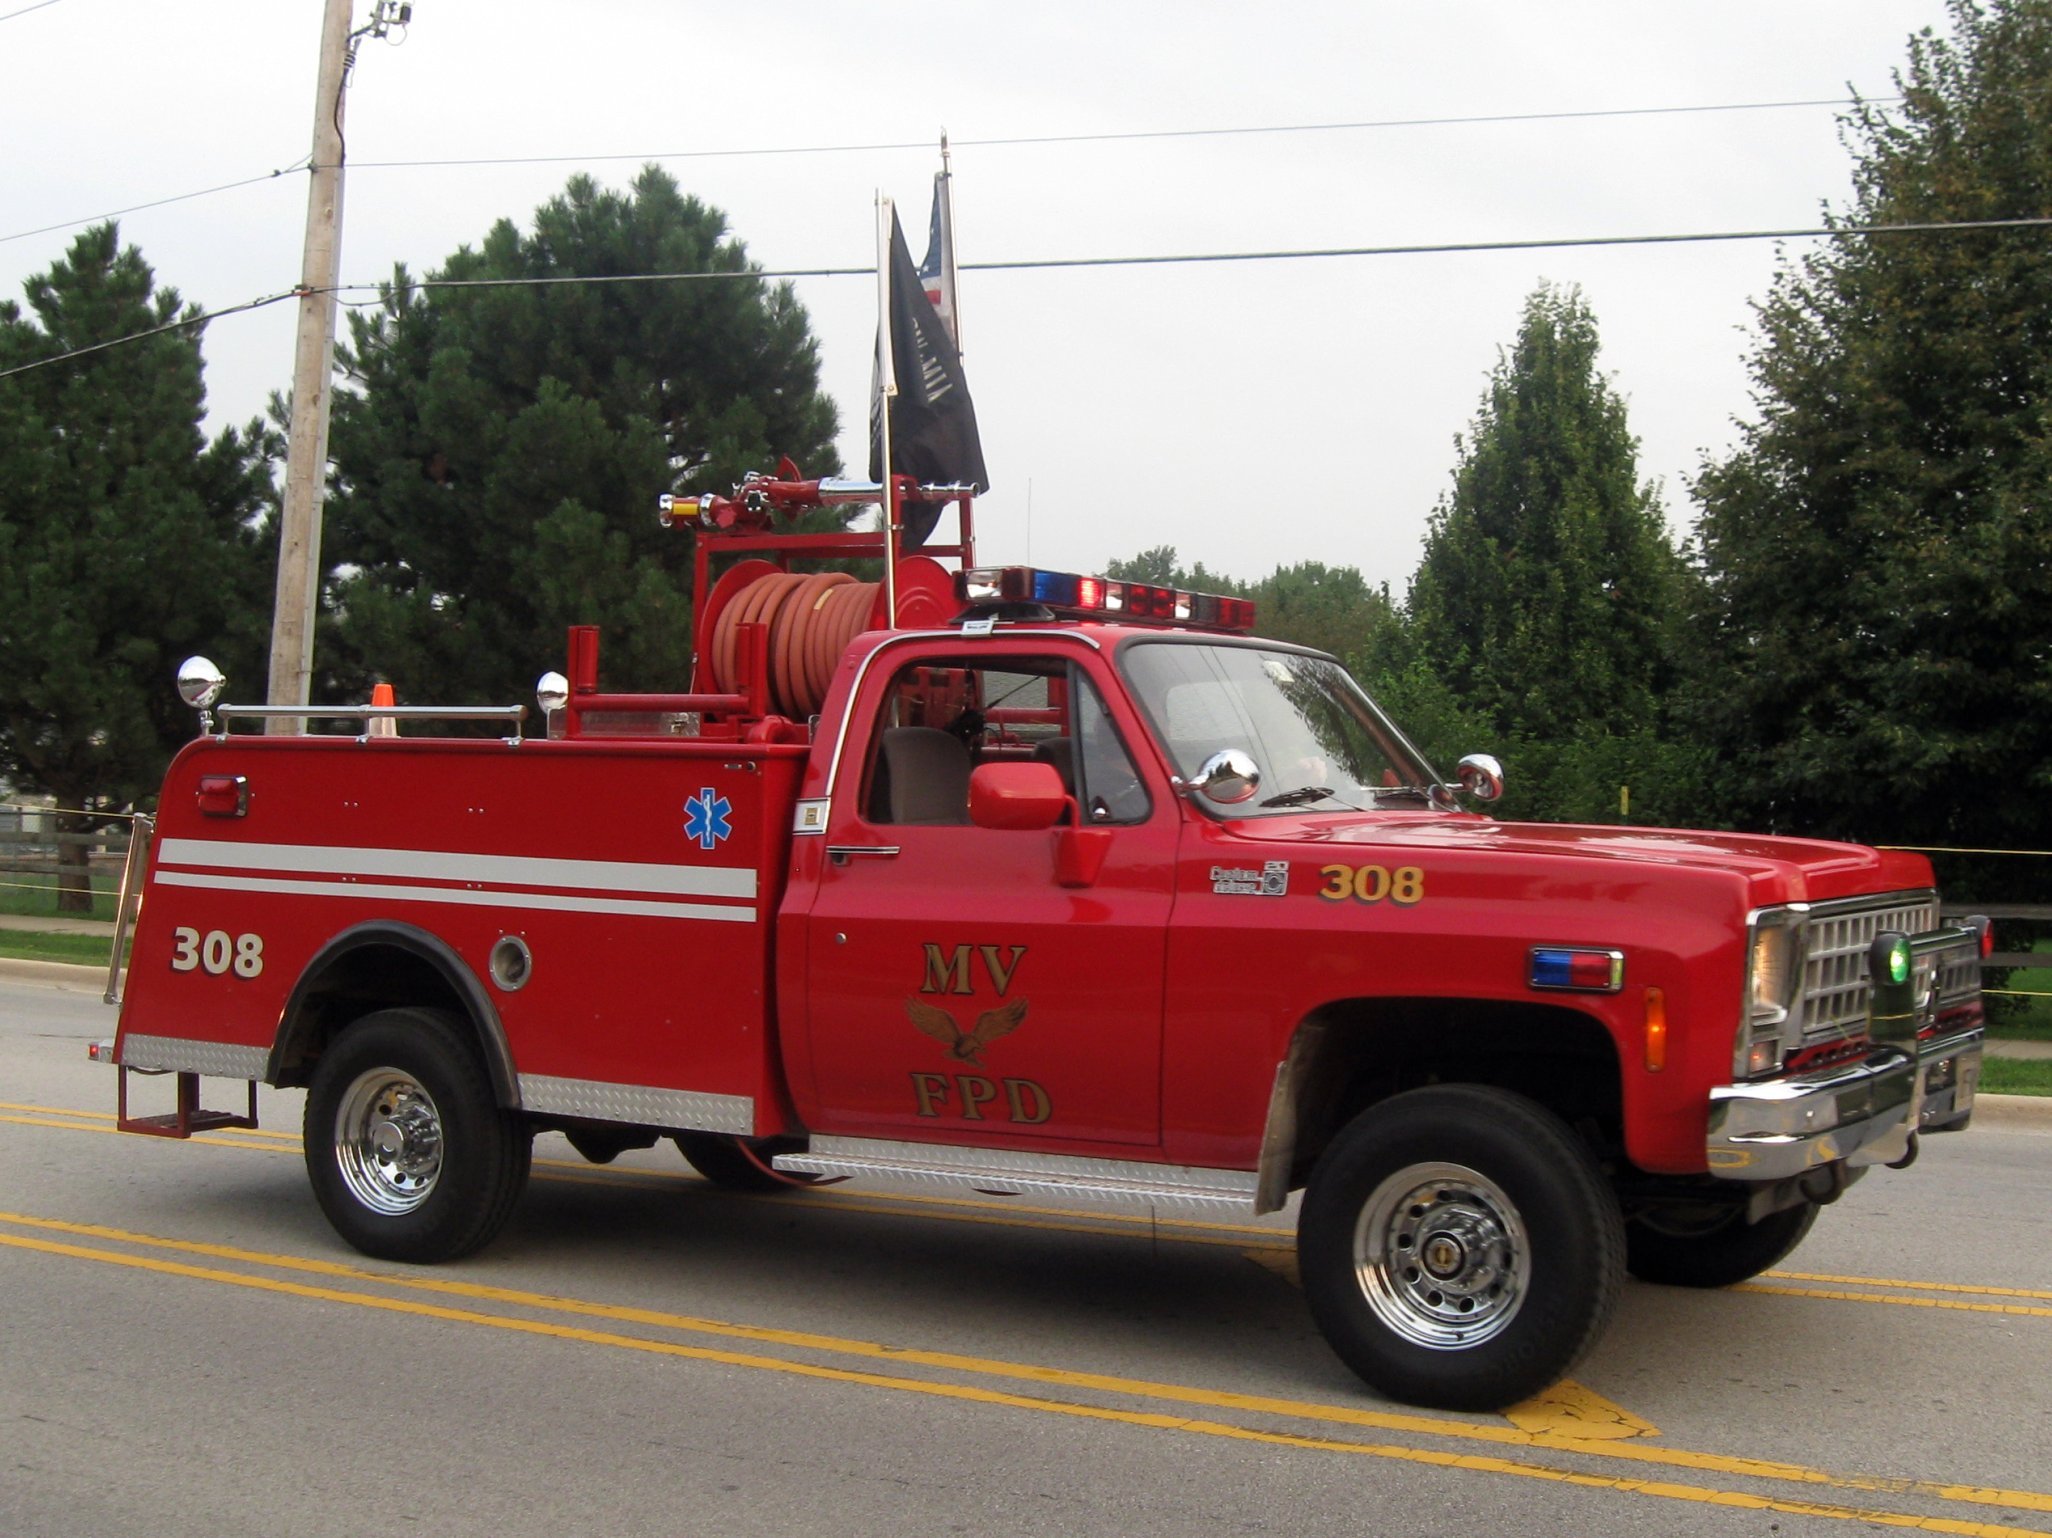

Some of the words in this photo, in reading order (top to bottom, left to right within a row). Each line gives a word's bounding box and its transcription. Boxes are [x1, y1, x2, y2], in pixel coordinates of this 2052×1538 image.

[1318, 864, 1425, 907] 308
[171, 926, 264, 979] 308
[920, 943, 1028, 996] MV
[910, 1072, 1052, 1124] FPD
